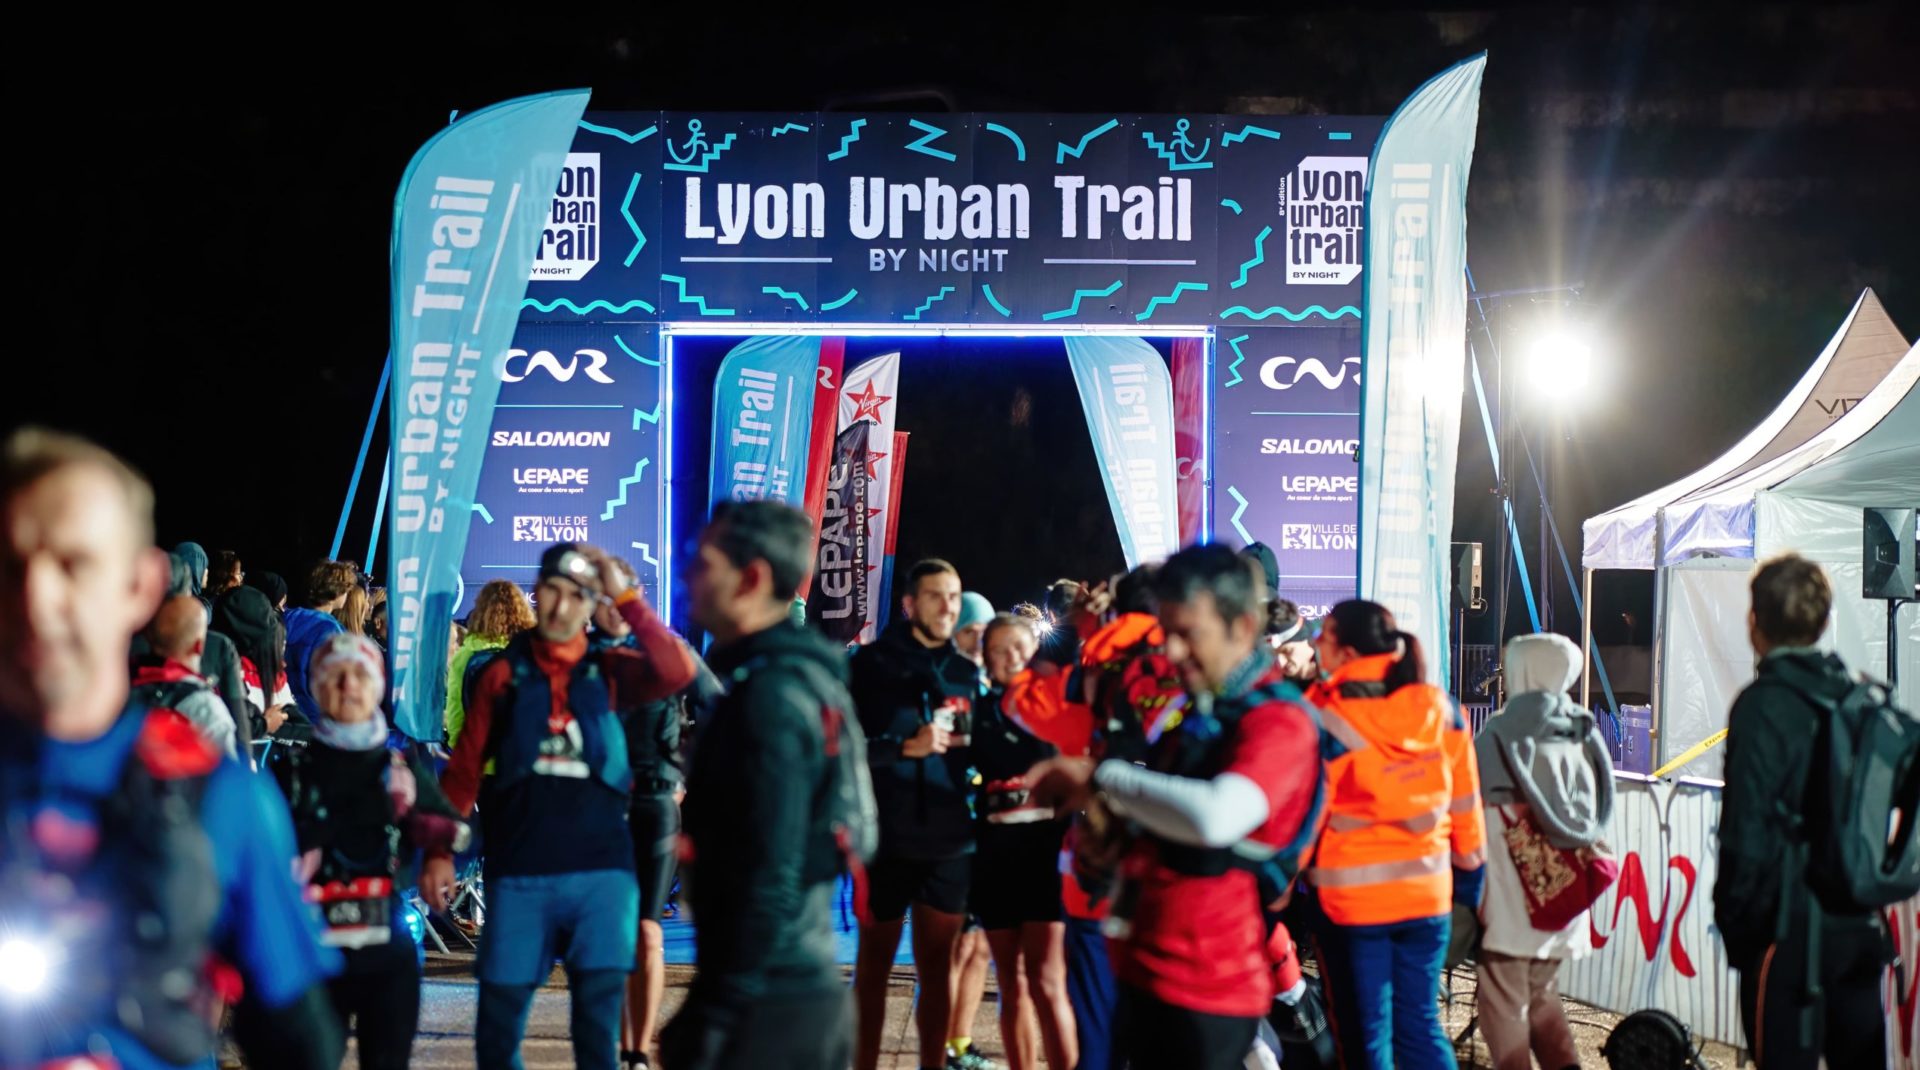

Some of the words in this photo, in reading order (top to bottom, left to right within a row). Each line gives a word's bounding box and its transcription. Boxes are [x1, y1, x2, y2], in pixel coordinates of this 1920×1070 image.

[555, 166, 595, 198] on
[1290, 165, 1363, 202] lyon
[551, 198, 596, 224] ban
[685, 176, 825, 245] Lyon
[849, 176, 1030, 241] Urban
[1054, 175, 1192, 241] Trail
[1290, 202, 1363, 228] urban
[412, 175, 495, 317] Trail
[536, 224, 596, 261] rail
[1290, 228, 1363, 265] trail
[540, 267, 572, 275] NIGHT
[869, 248, 907, 272] BY
[919, 248, 1008, 272] NIGHT
[1293, 271, 1307, 279] BY
[1308, 271, 1341, 279] NIGHT
[439, 341, 482, 470] NIGHT
[732, 367, 778, 447] Trail
[396, 342, 453, 533] Urban
[492, 431, 611, 448] SALOMON
[1260, 438, 1360, 454] SALOMO
[513, 467, 589, 485] LEPAPE
[1282, 475, 1358, 493] LEPAPE
[568, 487, 584, 495] sport
[543, 516, 572, 526] VILLE
[574, 516, 588, 526] DE
[543, 526, 588, 542] LYON
[1311, 523, 1340, 534] VILLE
[1342, 524, 1357, 534] DE
[821, 463, 852, 619] LEPAPE
[853, 461, 868, 618] www.lepape.com
[1312, 534, 1357, 550] LYON
